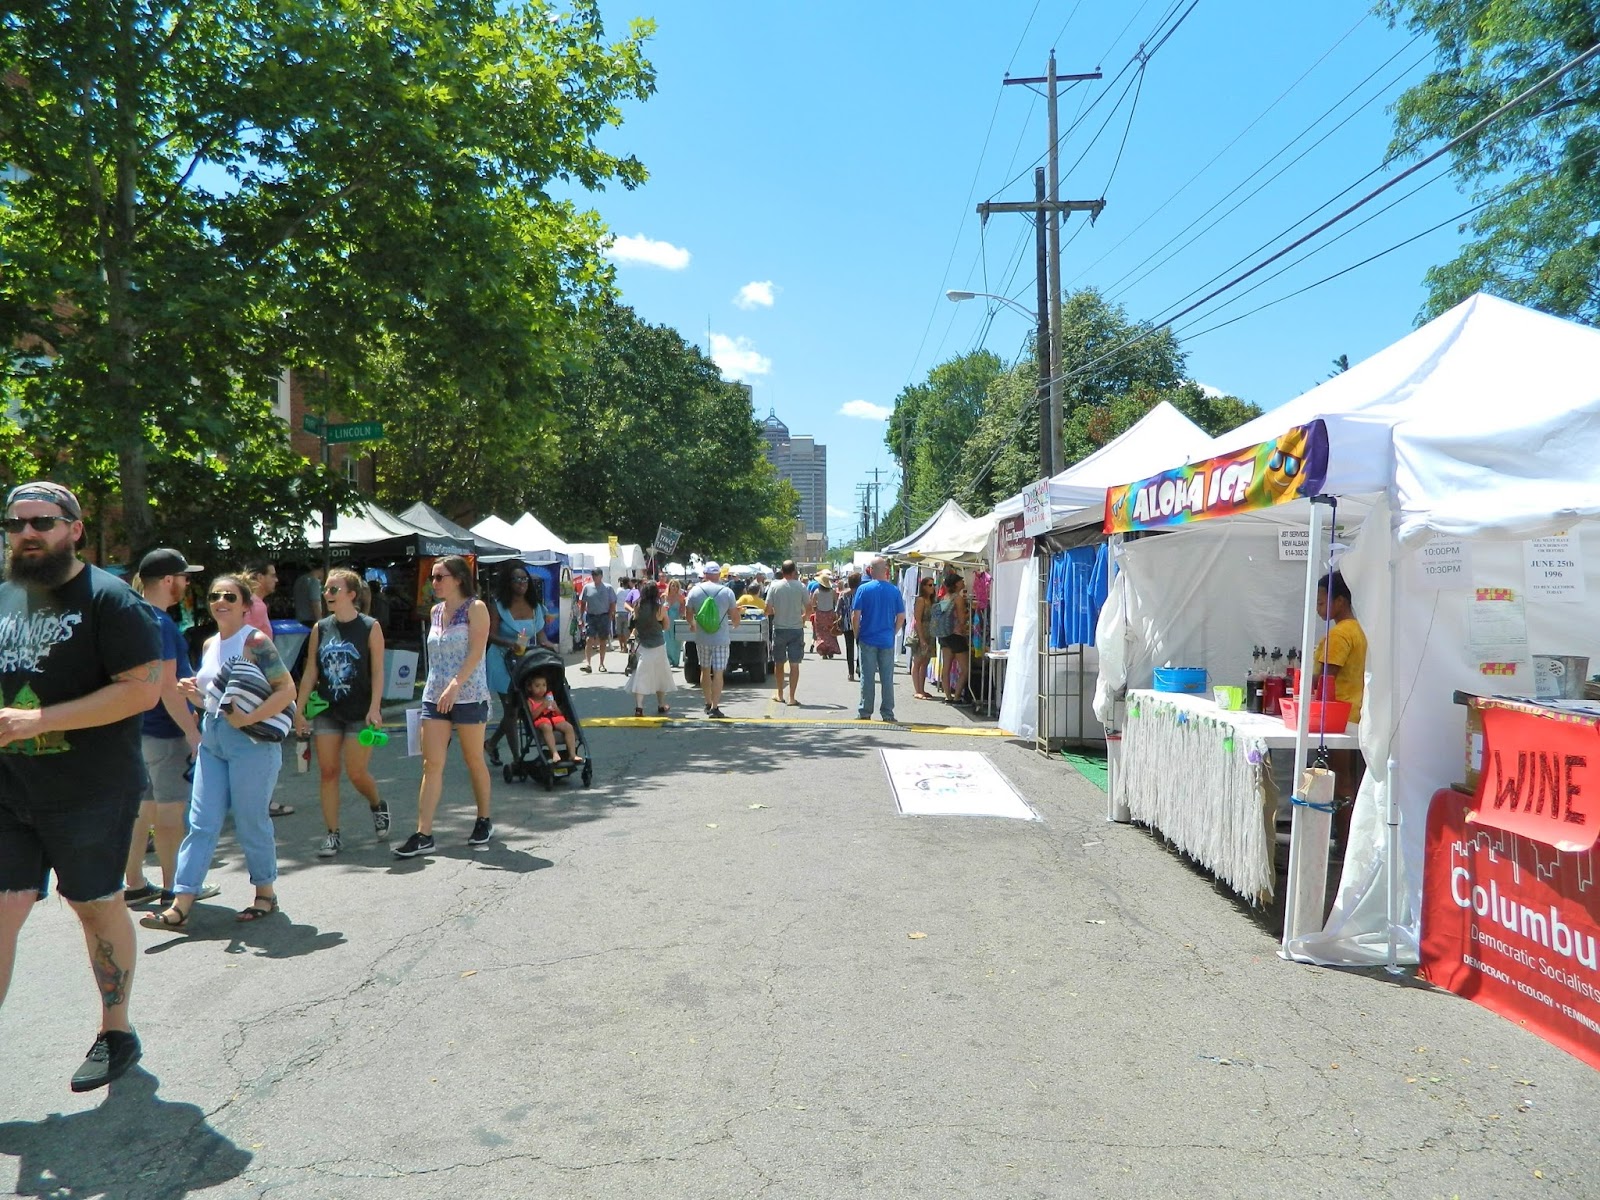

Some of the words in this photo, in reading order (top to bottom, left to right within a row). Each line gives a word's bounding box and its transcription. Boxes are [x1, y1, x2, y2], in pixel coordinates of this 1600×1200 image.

[335, 426, 371, 438] LINCOLN
[1132, 472, 1205, 522] ALOHA
[1207, 456, 1256, 507] ICE
[1424, 547, 1460, 555] 10:00PM
[1426, 565, 1461, 574] 10:30PM
[1493, 750, 1587, 825] WINE
[1451, 866, 1597, 970] Columbu
[1463, 953, 1510, 985] DEMOCRACY
[1517, 981, 1554, 1008] ECOLOGY
[1471, 924, 1536, 970] Democratic
[1539, 957, 1600, 1003] Socialists
